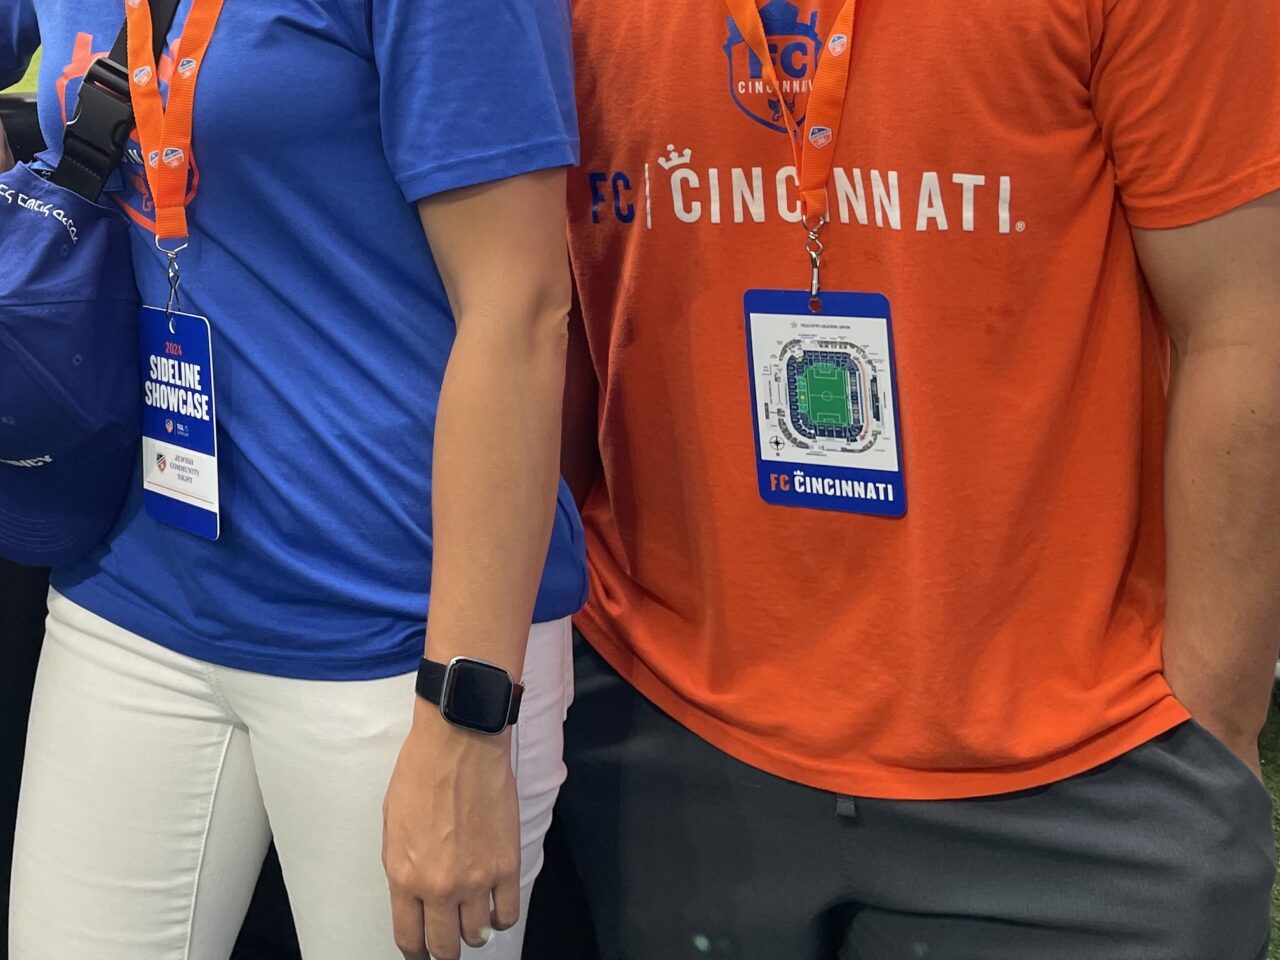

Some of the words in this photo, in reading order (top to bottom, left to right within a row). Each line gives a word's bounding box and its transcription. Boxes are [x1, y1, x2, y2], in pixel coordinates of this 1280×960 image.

[588, 171, 635, 224] FC
[670, 167, 1011, 234] CINCNNATI
[165, 341, 183, 356] 2024
[149, 354, 202, 391] SIDELINE
[145, 380, 210, 421] SHOWCASE
[169, 462, 200, 477] COMMUNITY
[769, 473, 790, 492] FC
[794, 474, 894, 502] CINCINNATI
